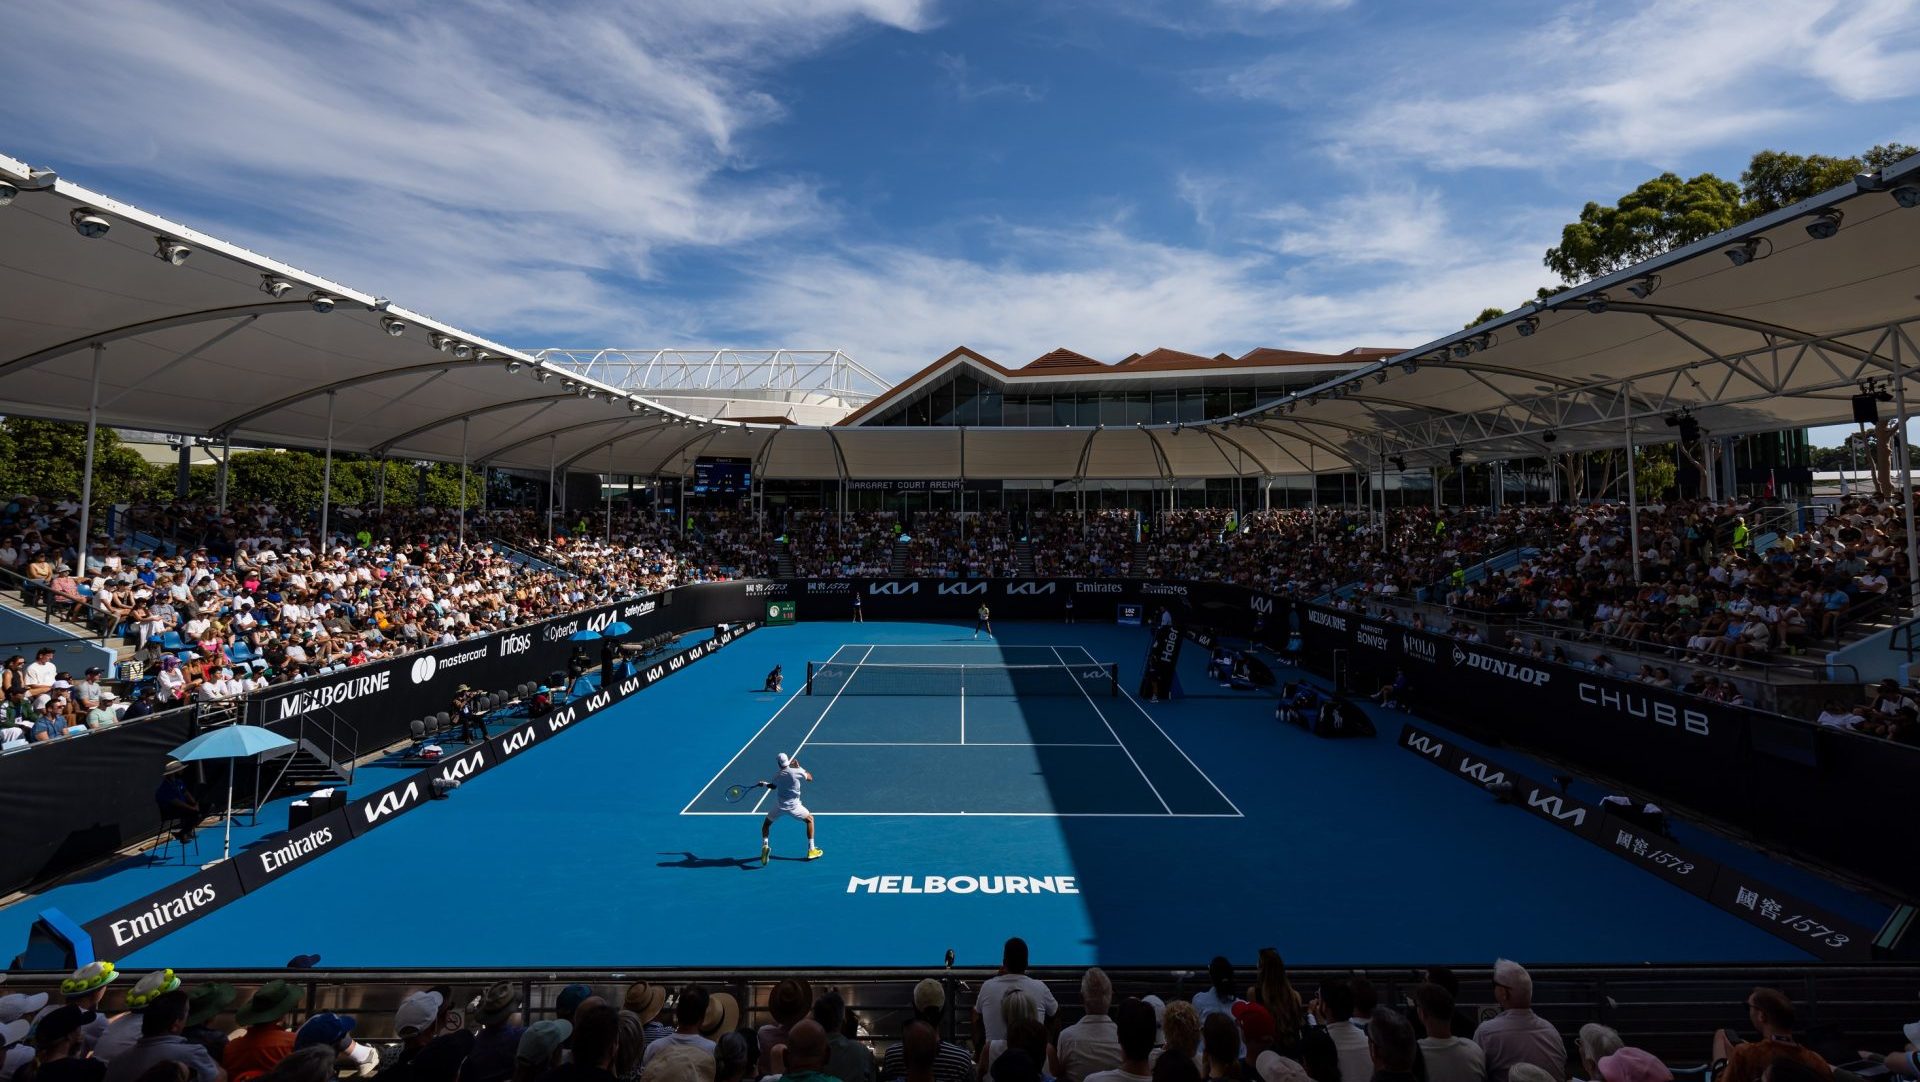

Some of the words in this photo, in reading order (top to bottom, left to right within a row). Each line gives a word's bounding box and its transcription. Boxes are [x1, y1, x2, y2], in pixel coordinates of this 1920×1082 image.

[847, 481, 893, 489] MARGARET
[897, 481, 925, 489] COURT
[930, 481, 960, 489] ARENA
[870, 582, 918, 594] KIA
[939, 582, 987, 594] KIA
[1007, 582, 1056, 594] KIA
[1076, 582, 1123, 593] Emirates
[1142, 583, 1188, 595] Emirates
[624, 601, 655, 617] SafetyCulture
[1308, 609, 1347, 632] MELBOURNE
[550, 620, 579, 642] CyberCX
[1357, 631, 1389, 651] BONVOY
[500, 632, 531, 657] Infosys
[1161, 627, 1179, 663] Haier
[1408, 636, 1436, 657] POLO
[438, 645, 488, 670] mastercard
[1466, 652, 1551, 687] DUNLOP
[280, 670, 391, 720] MELBOURNE
[549, 706, 576, 732] KIA
[1579, 682, 1710, 736] CHUBB
[503, 726, 536, 755] KIA
[1407, 731, 1444, 758] KIA
[364, 781, 419, 823] KIA
[1527, 788, 1587, 827] KIA
[260, 826, 333, 873] Emirates
[846, 875, 1080, 894] MELBOURNE
[110, 883, 216, 947] Emirates
